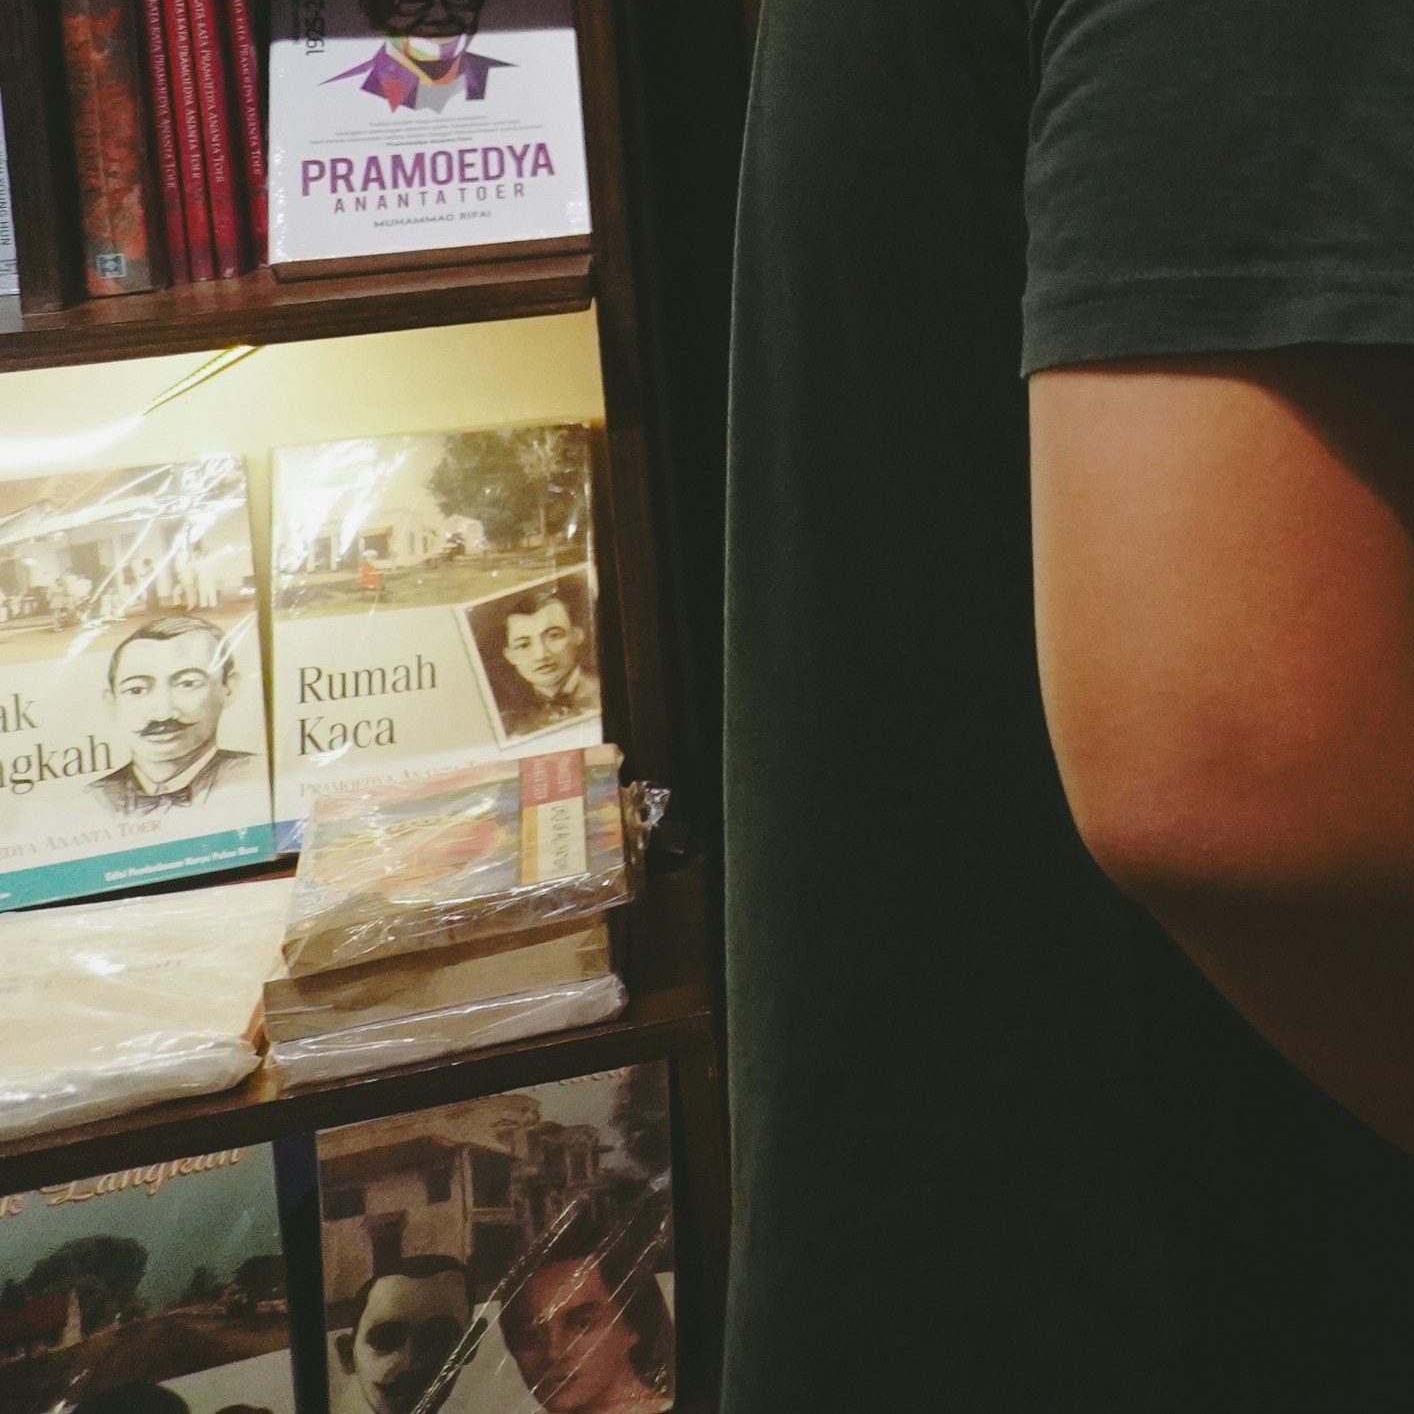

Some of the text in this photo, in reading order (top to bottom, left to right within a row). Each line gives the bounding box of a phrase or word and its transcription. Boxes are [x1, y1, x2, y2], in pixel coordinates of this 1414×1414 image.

[301, 142, 556, 197] PRAMOEDYA
[333, 183, 527, 214] ANANTA TOER
[373, 213, 455, 229] MUHAMMAD
[297, 653, 438, 705] Rumah
[297, 715, 397, 757] Kaca
